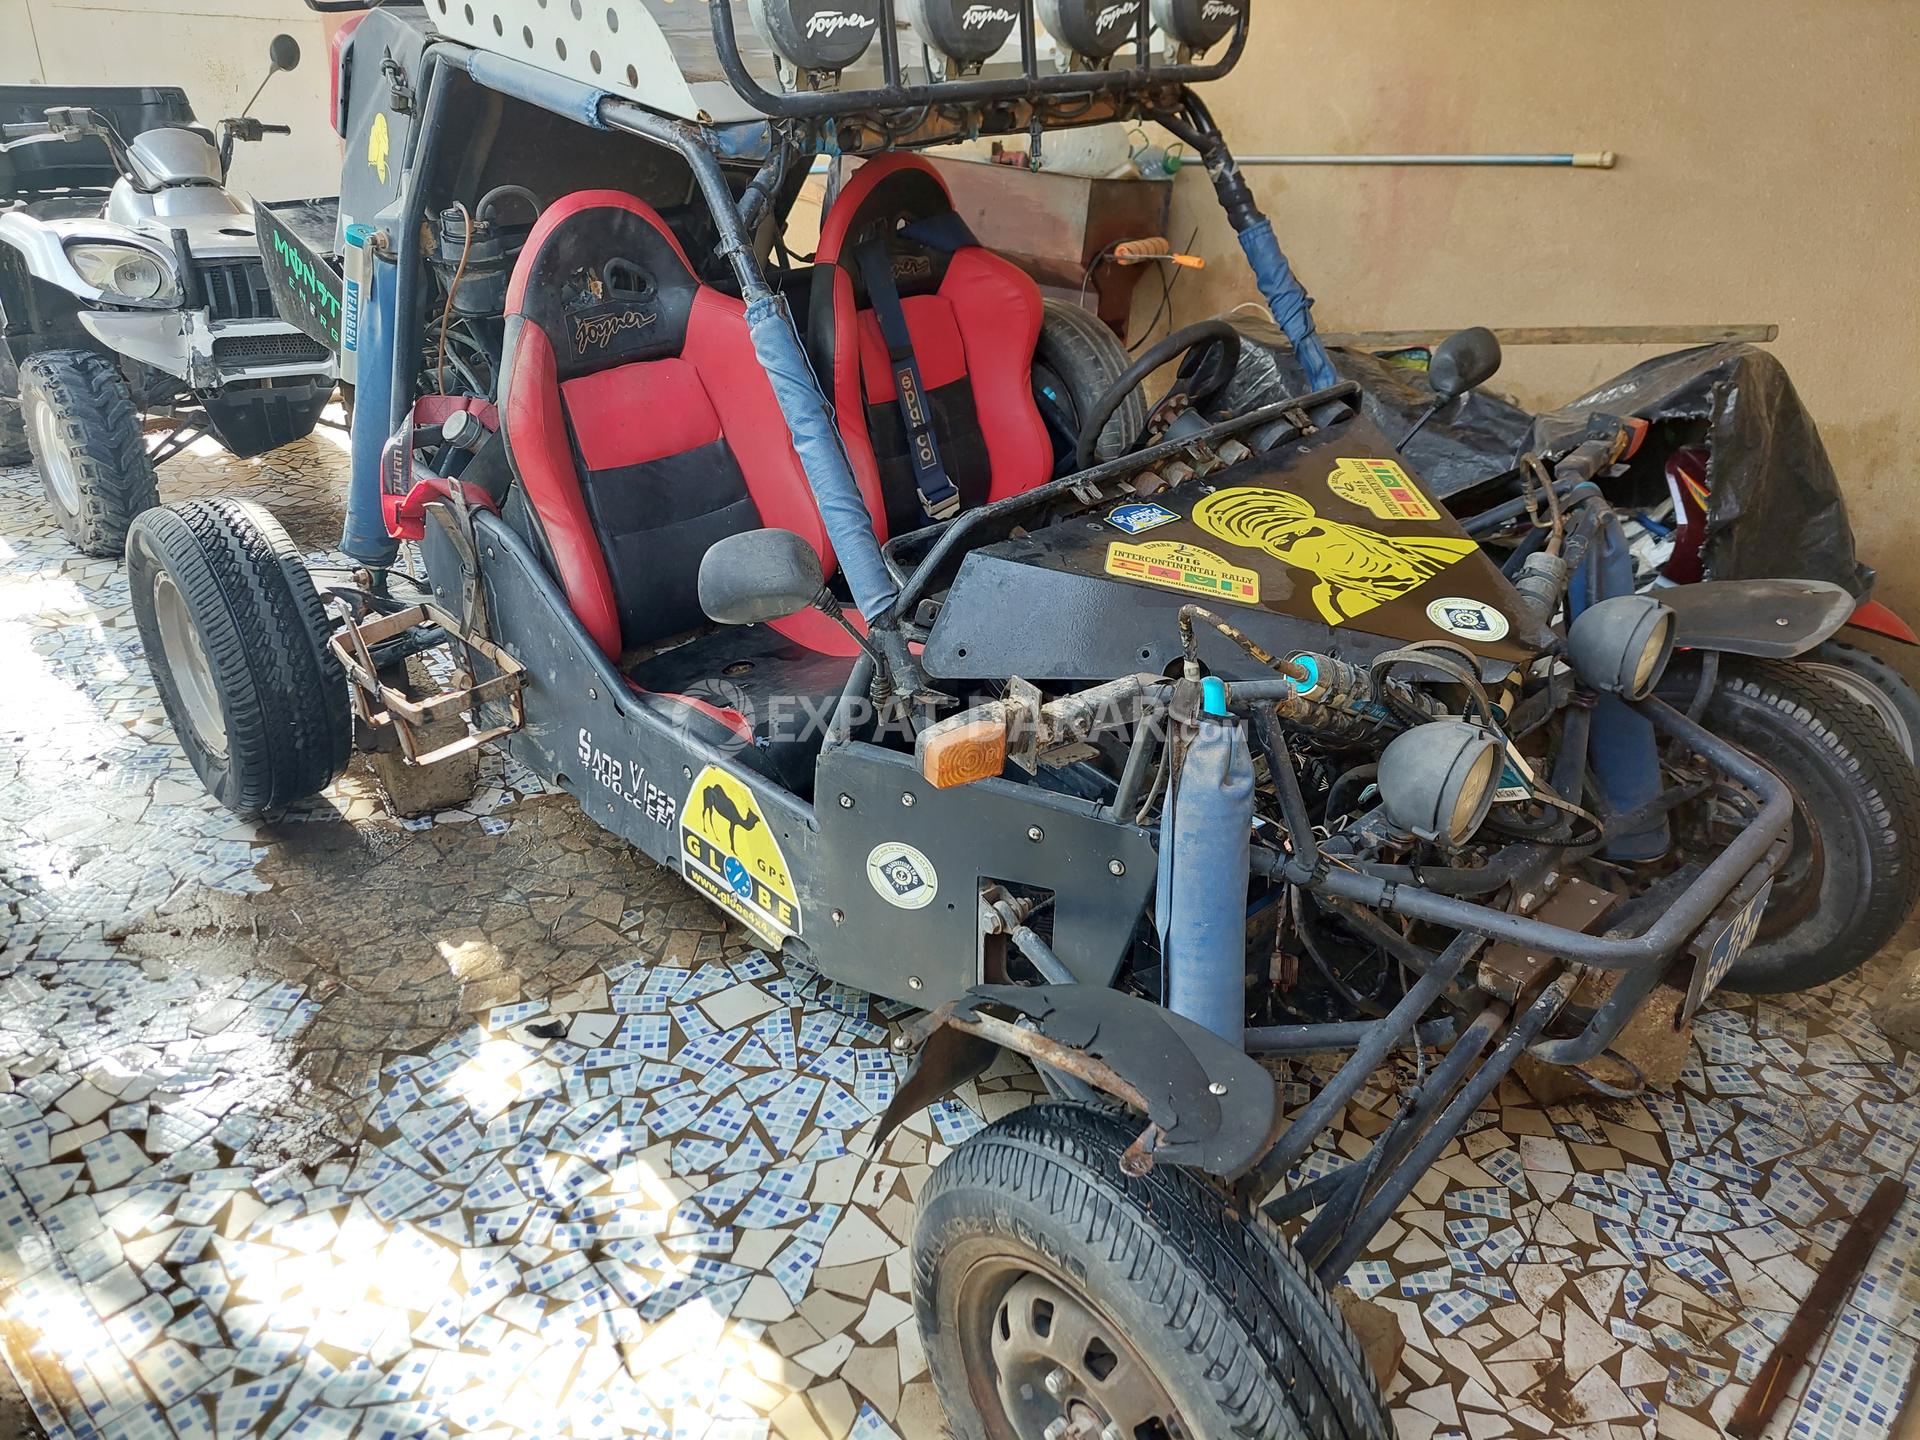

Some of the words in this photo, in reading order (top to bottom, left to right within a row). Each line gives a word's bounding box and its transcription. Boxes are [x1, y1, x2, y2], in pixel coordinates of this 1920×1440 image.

[1113, 549, 1217, 577] INTERCONTINENTAL
[1221, 572, 1254, 584] RALLY
[1167, 553, 1201, 566] 2016
[757, 858, 786, 886] GPS
